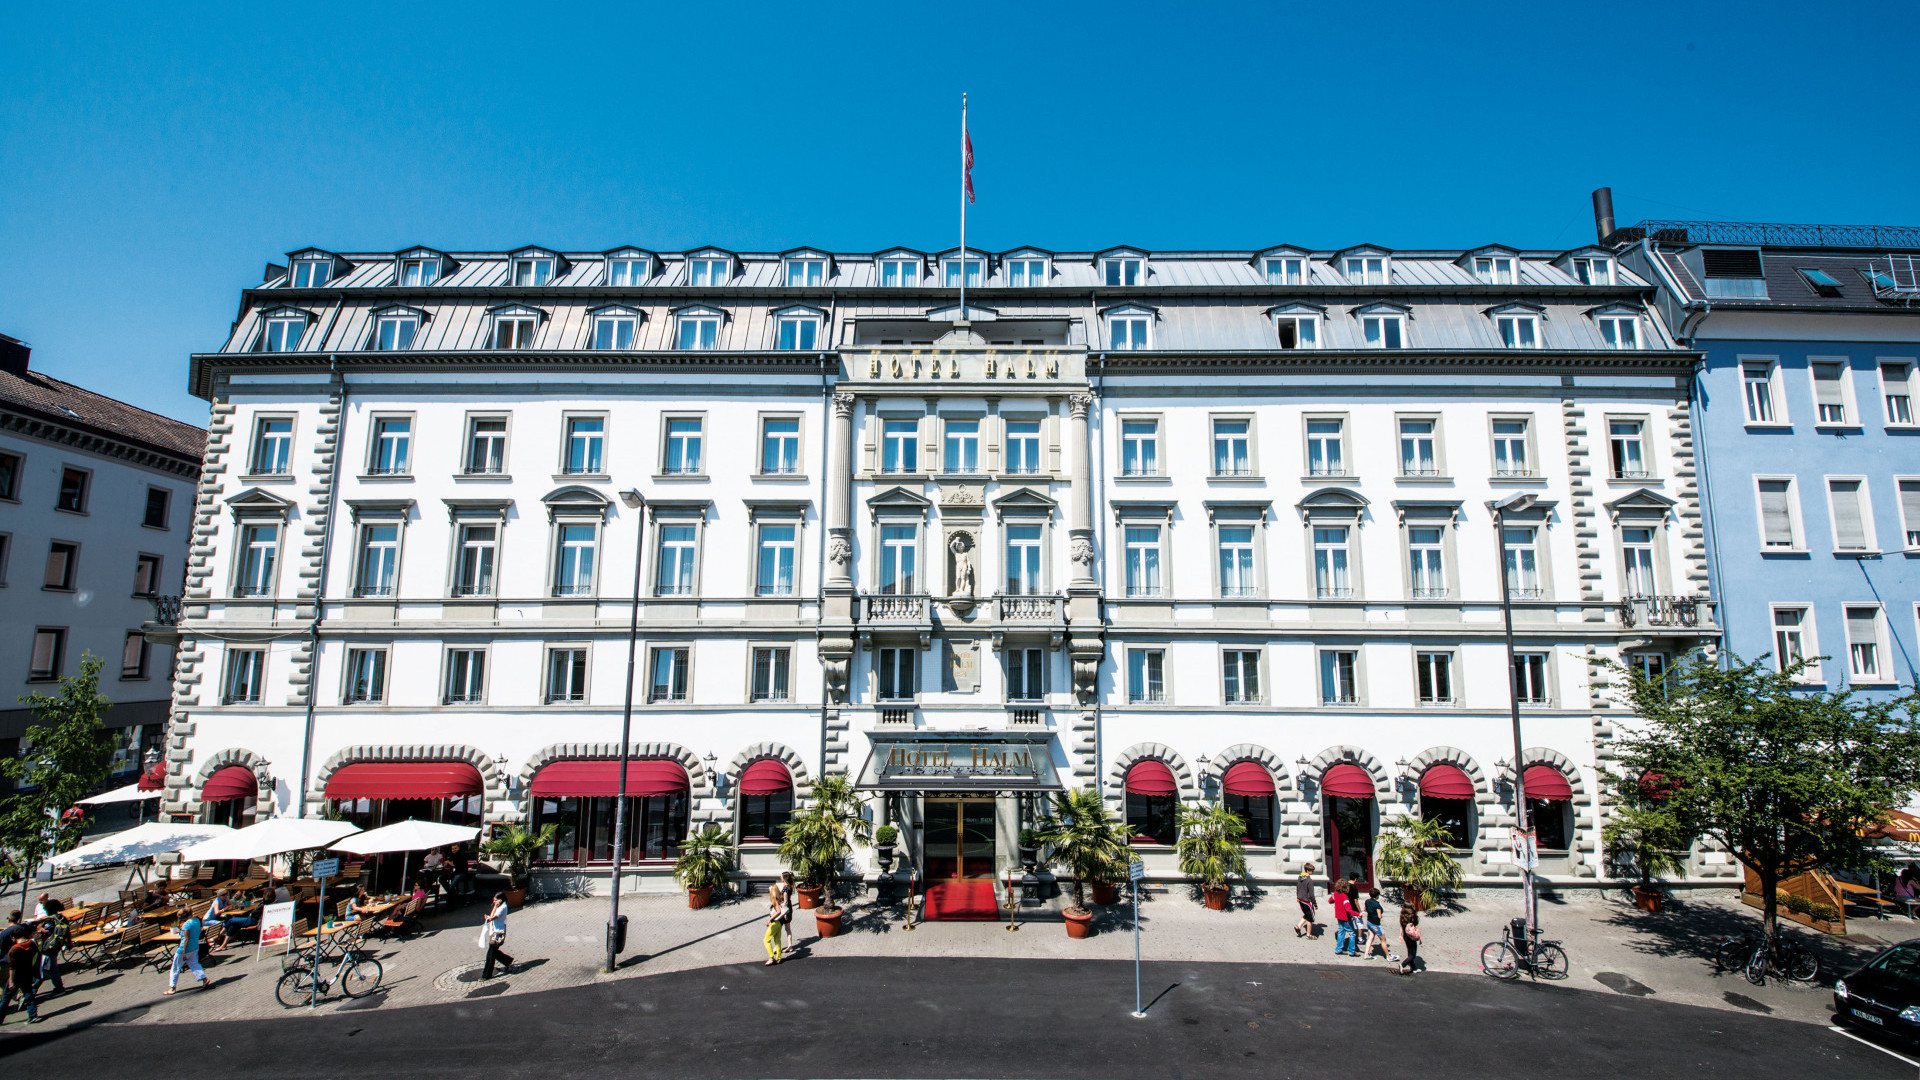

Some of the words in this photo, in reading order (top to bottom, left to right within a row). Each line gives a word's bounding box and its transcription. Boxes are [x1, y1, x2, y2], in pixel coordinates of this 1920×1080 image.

[869, 353, 960, 377] HOTEL
[984, 353, 1058, 376] HALM
[950, 661, 973, 669] HALM
